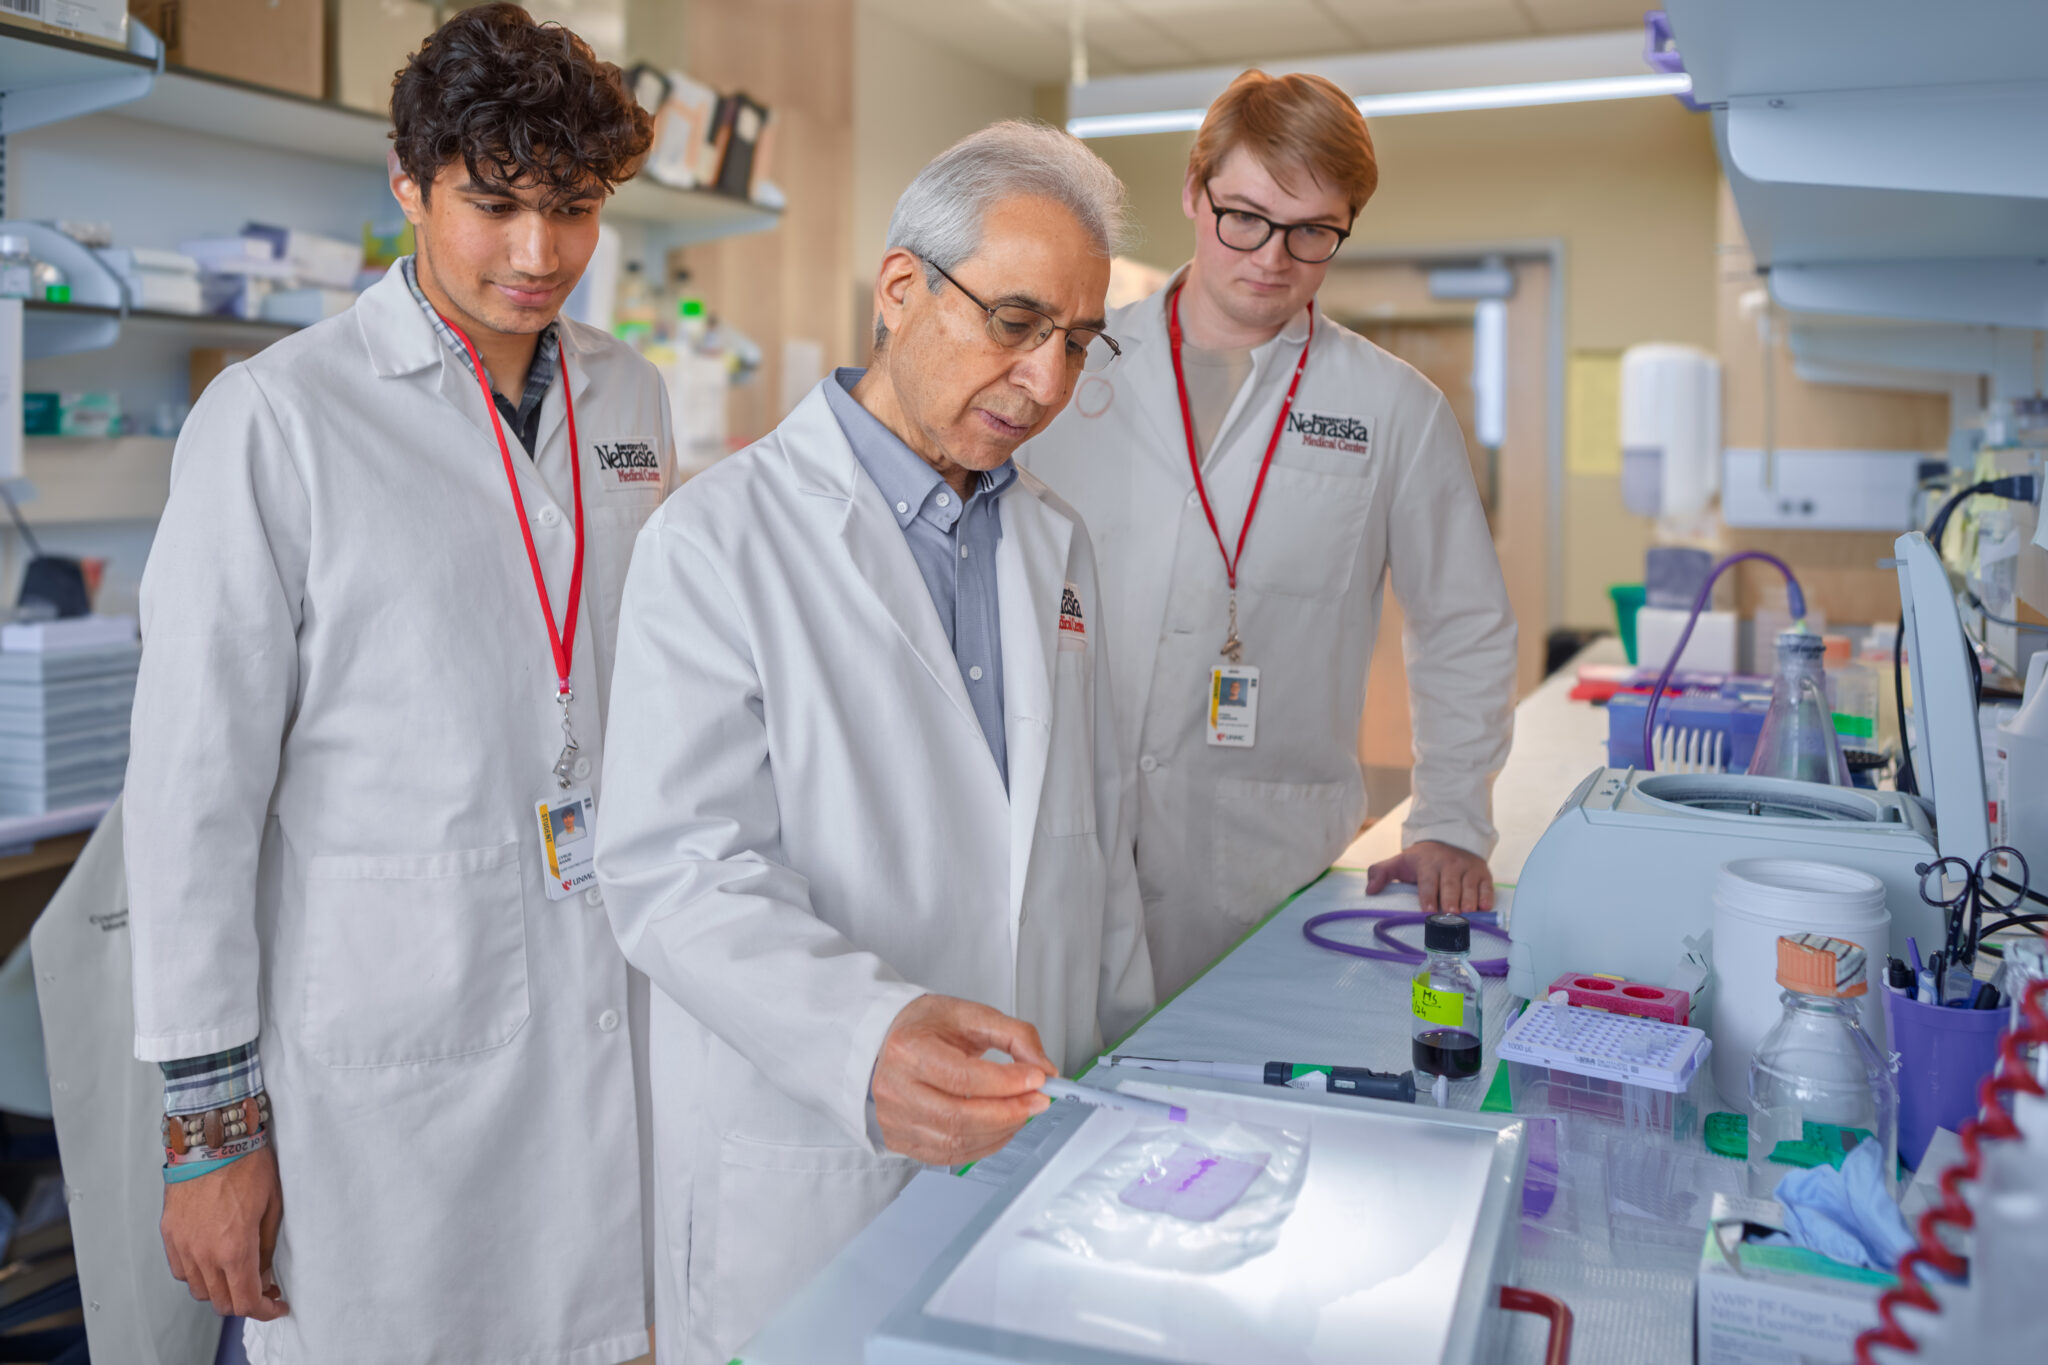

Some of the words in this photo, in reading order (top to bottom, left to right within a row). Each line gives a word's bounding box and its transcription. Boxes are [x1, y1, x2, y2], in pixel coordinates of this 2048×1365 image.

[1286, 411, 1369, 442] Nebraska
[1302, 434, 1337, 450] Medical
[1338, 440, 1368, 454] Center
[593, 442, 658, 470] Nebraska
[616, 468, 644, 482] Medical
[541, 813, 553, 842] STUDENT
[572, 871, 597, 886] UNMC
[221, 1141, 248, 1156] 2022
